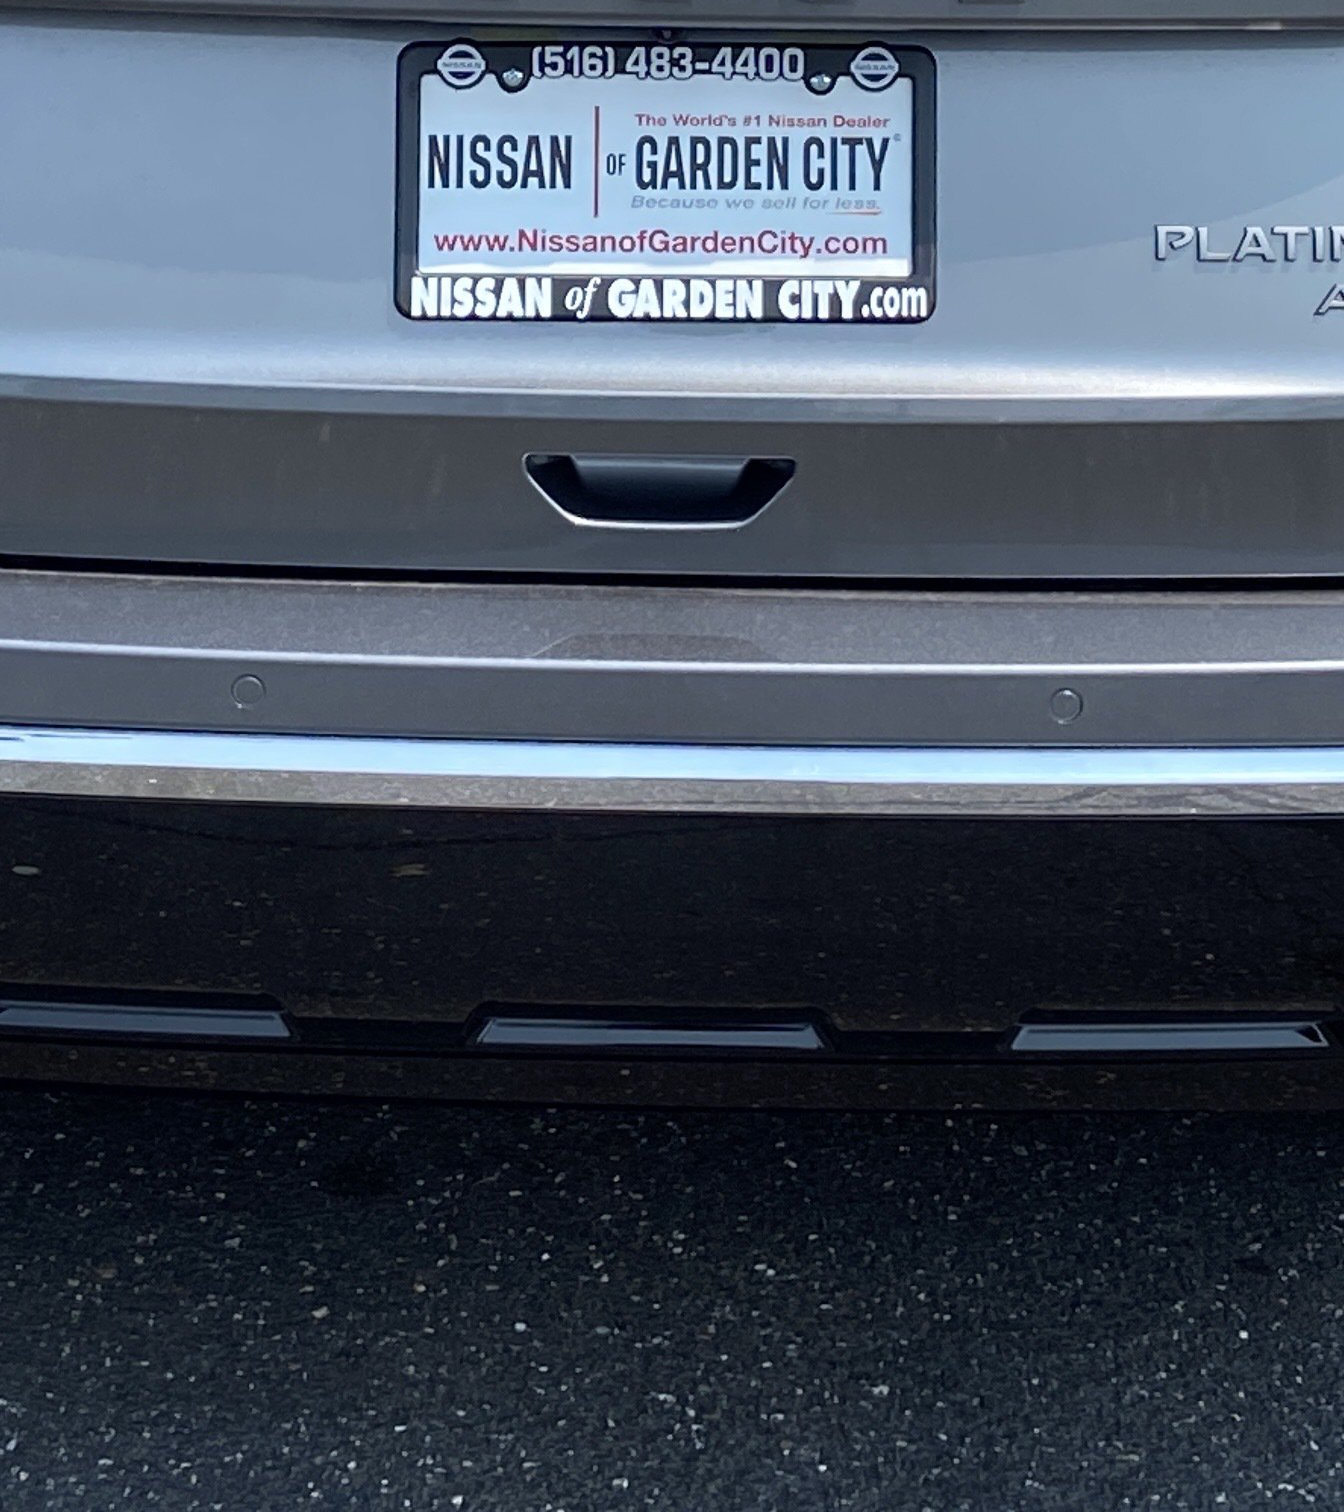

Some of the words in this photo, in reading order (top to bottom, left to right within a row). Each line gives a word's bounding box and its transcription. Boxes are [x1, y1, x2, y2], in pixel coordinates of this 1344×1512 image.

[532, 45, 616, 79] (516)
[625, 46, 805, 81] 483-4400
[635, 113, 667, 127] The
[672, 113, 737, 128] World's
[742, 114, 761, 128] #1
[768, 114, 828, 128] Nissan
[833, 114, 891, 129] Dealer
[427, 134, 572, 189] NISSAN
[606, 152, 627, 176] OF
[636, 135, 790, 191] GARDEN
[803, 136, 890, 191] CITY
[631, 195, 719, 209] Because
[725, 198, 755, 209] we
[761, 196, 796, 209] sell
[802, 196, 829, 209] for
[433, 229, 888, 259] www.NissanofGardenCity.com
[410, 276, 553, 318] NISSAN
[565, 276, 601, 319] of
[607, 278, 763, 319] GARDEN
